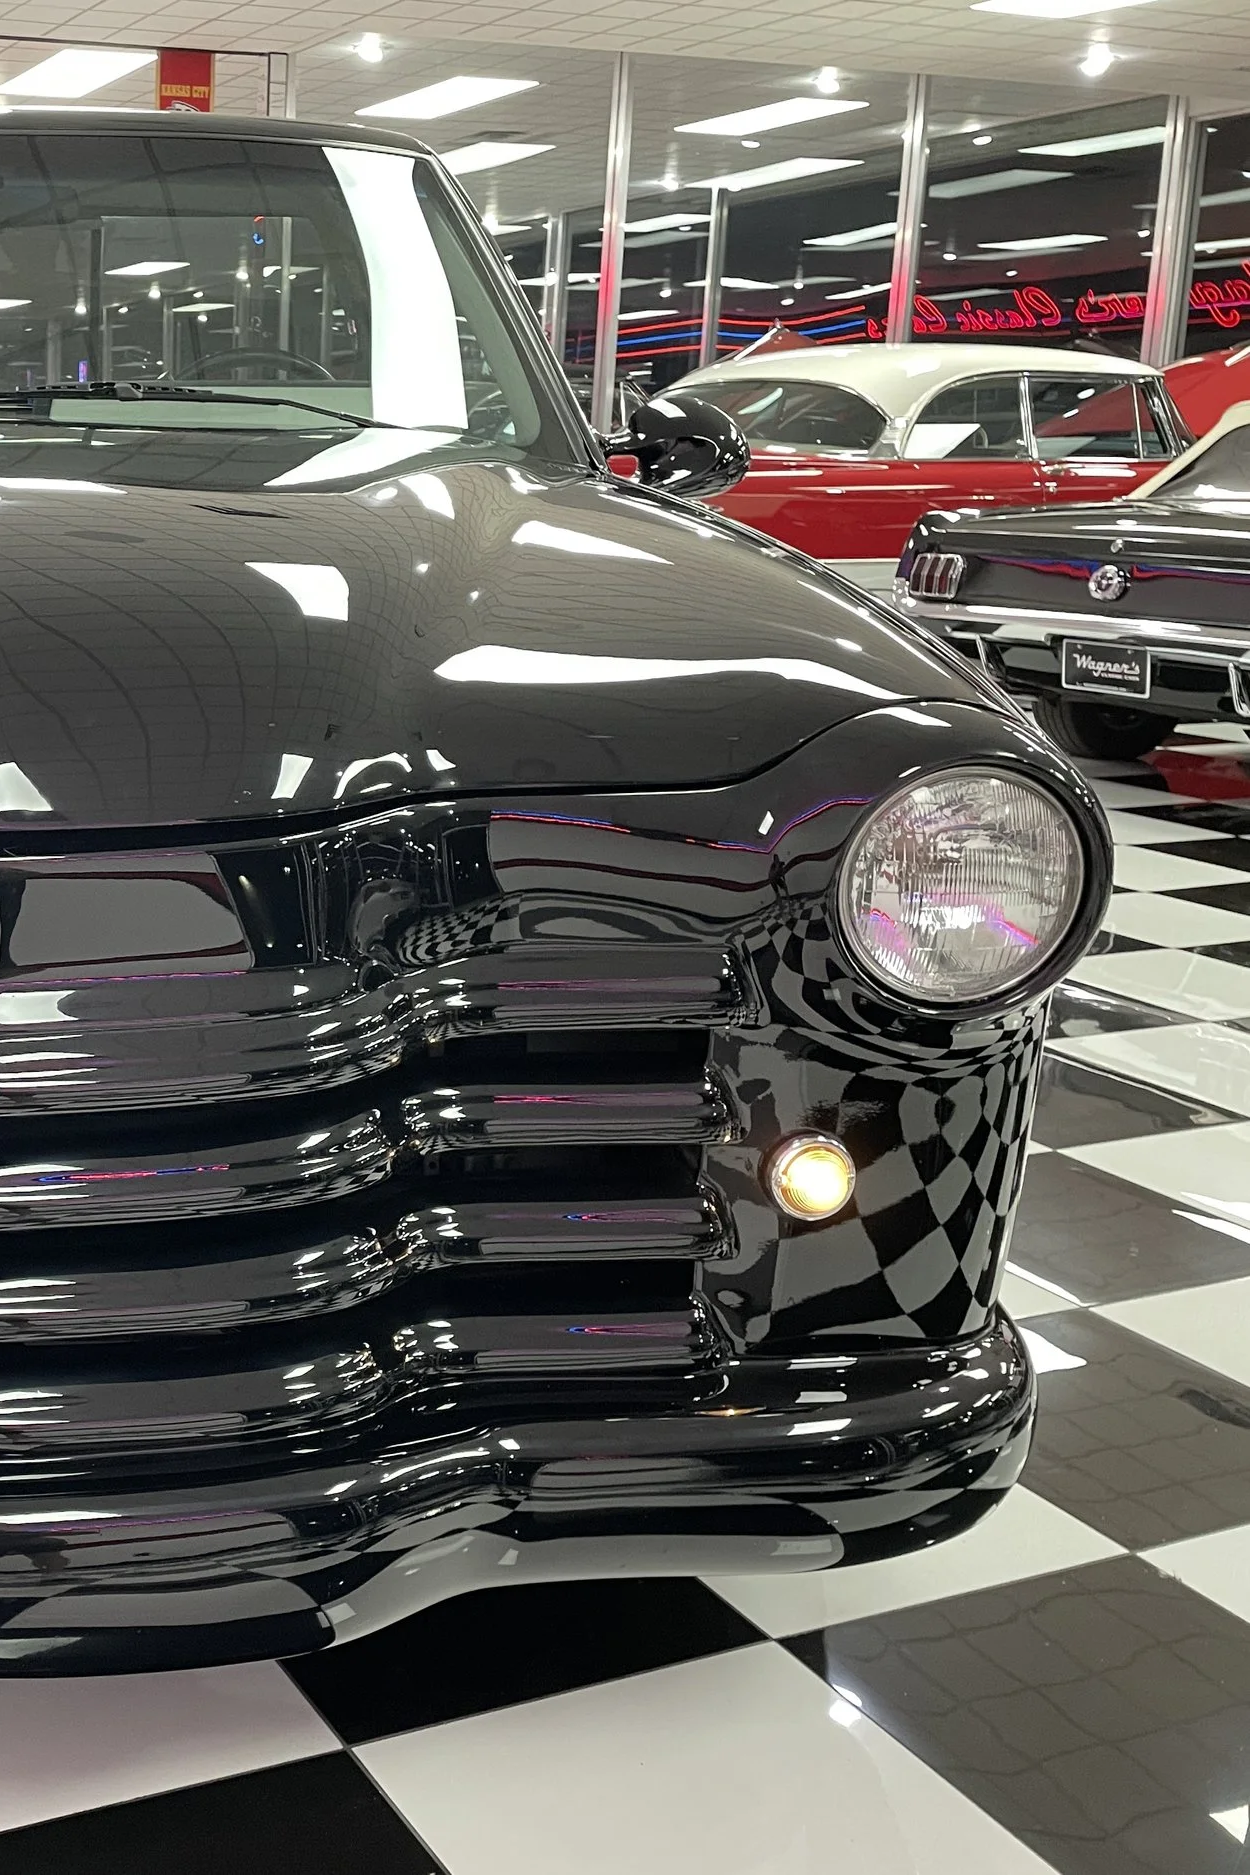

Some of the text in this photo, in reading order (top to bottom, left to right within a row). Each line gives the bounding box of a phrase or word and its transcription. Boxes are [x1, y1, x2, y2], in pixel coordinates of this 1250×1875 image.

[161, 84, 210, 98] KANSAS CITY
[1073, 653, 1140, 677] Wagner's
